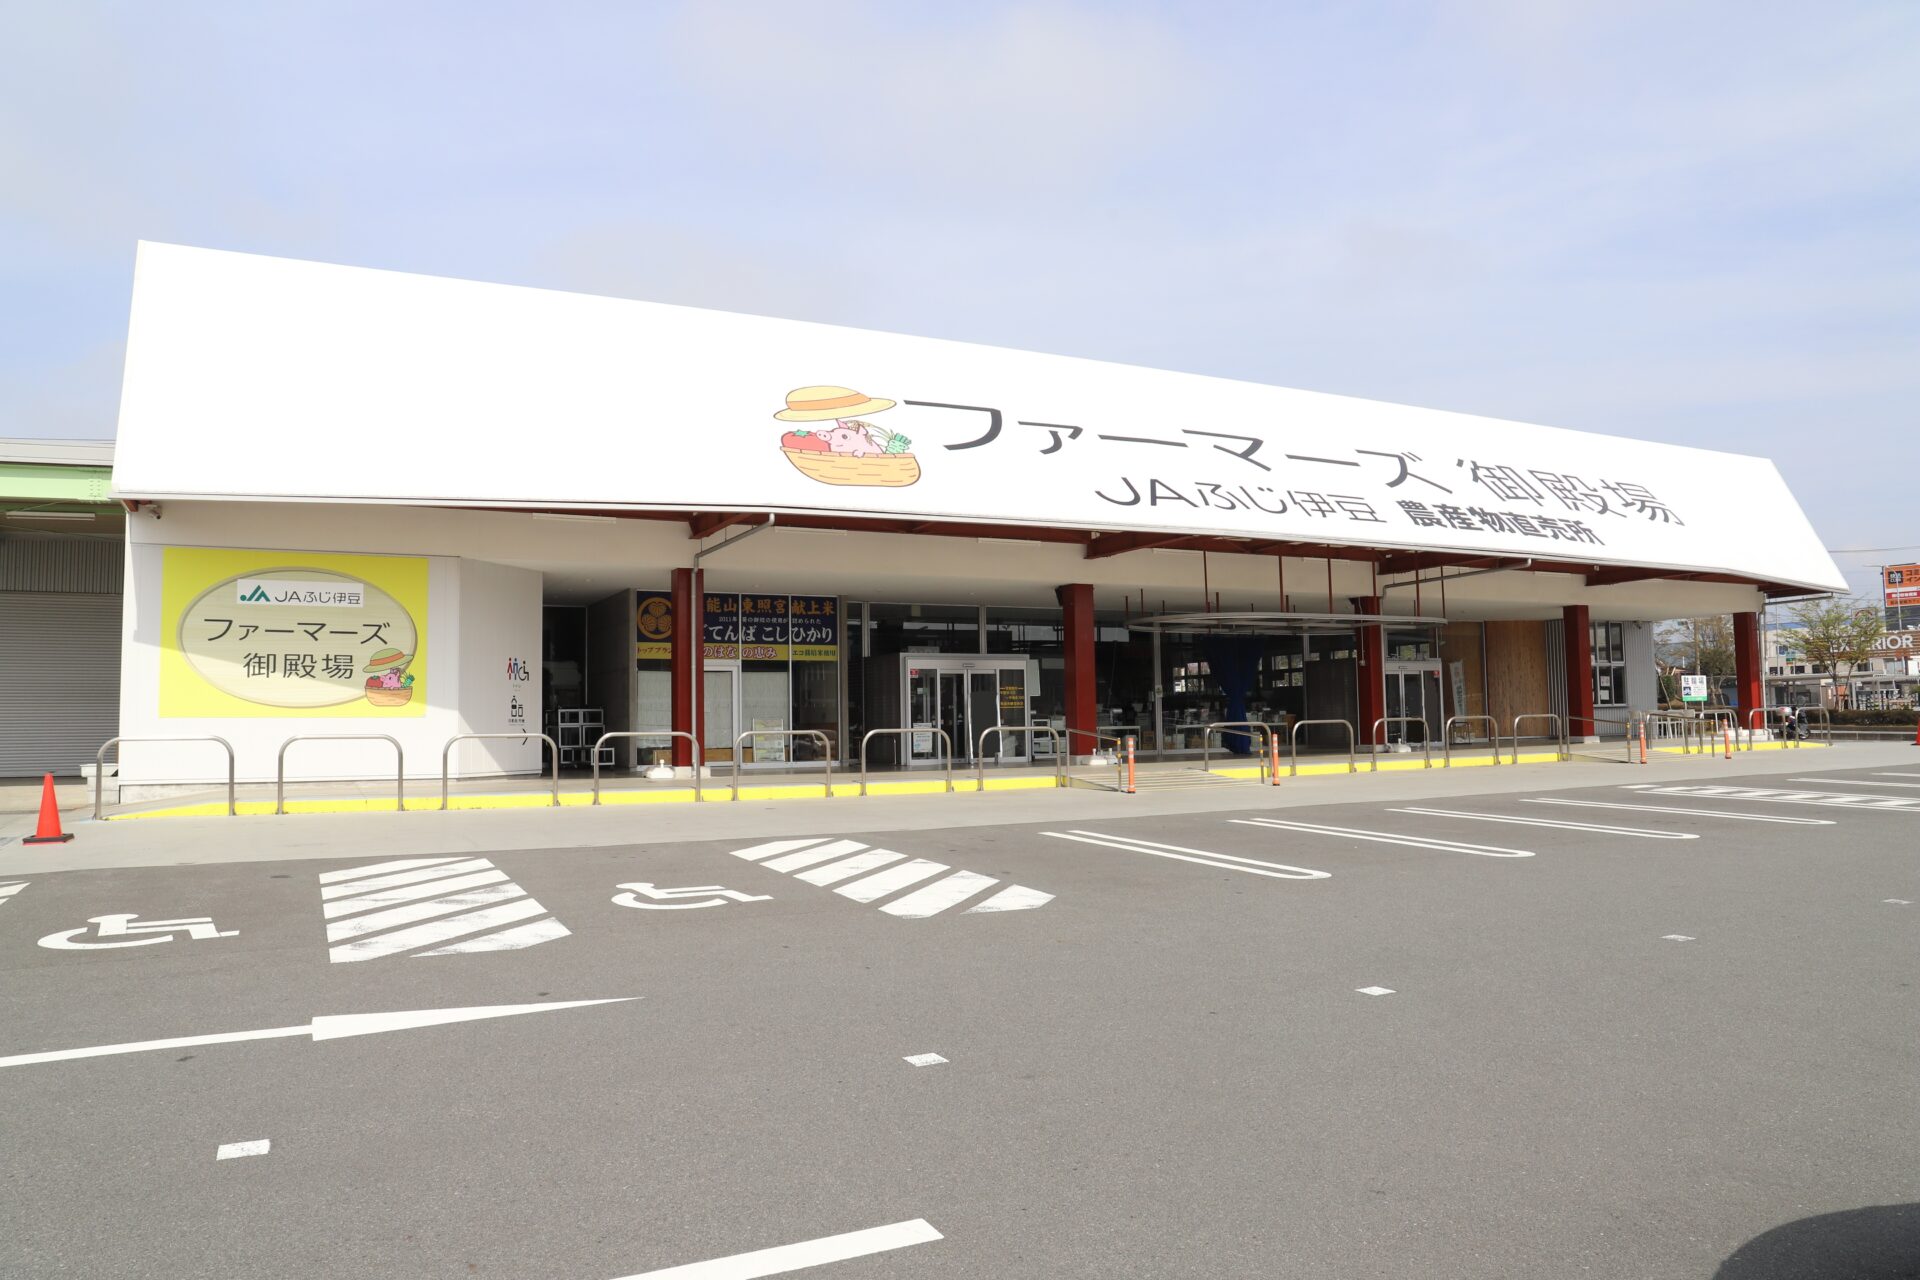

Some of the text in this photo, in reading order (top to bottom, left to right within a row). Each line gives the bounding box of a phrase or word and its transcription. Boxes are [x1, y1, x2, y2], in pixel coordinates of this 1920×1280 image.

[1095, 477, 1606, 546] JAふじ伊豆 農産物直売所
[274, 590, 361, 605] JAふじ伊豆
[703, 596, 836, 616] 能山東照宮献上米
[203, 618, 391, 645] ファーマーズ
[242, 652, 355, 680] 御殿場
